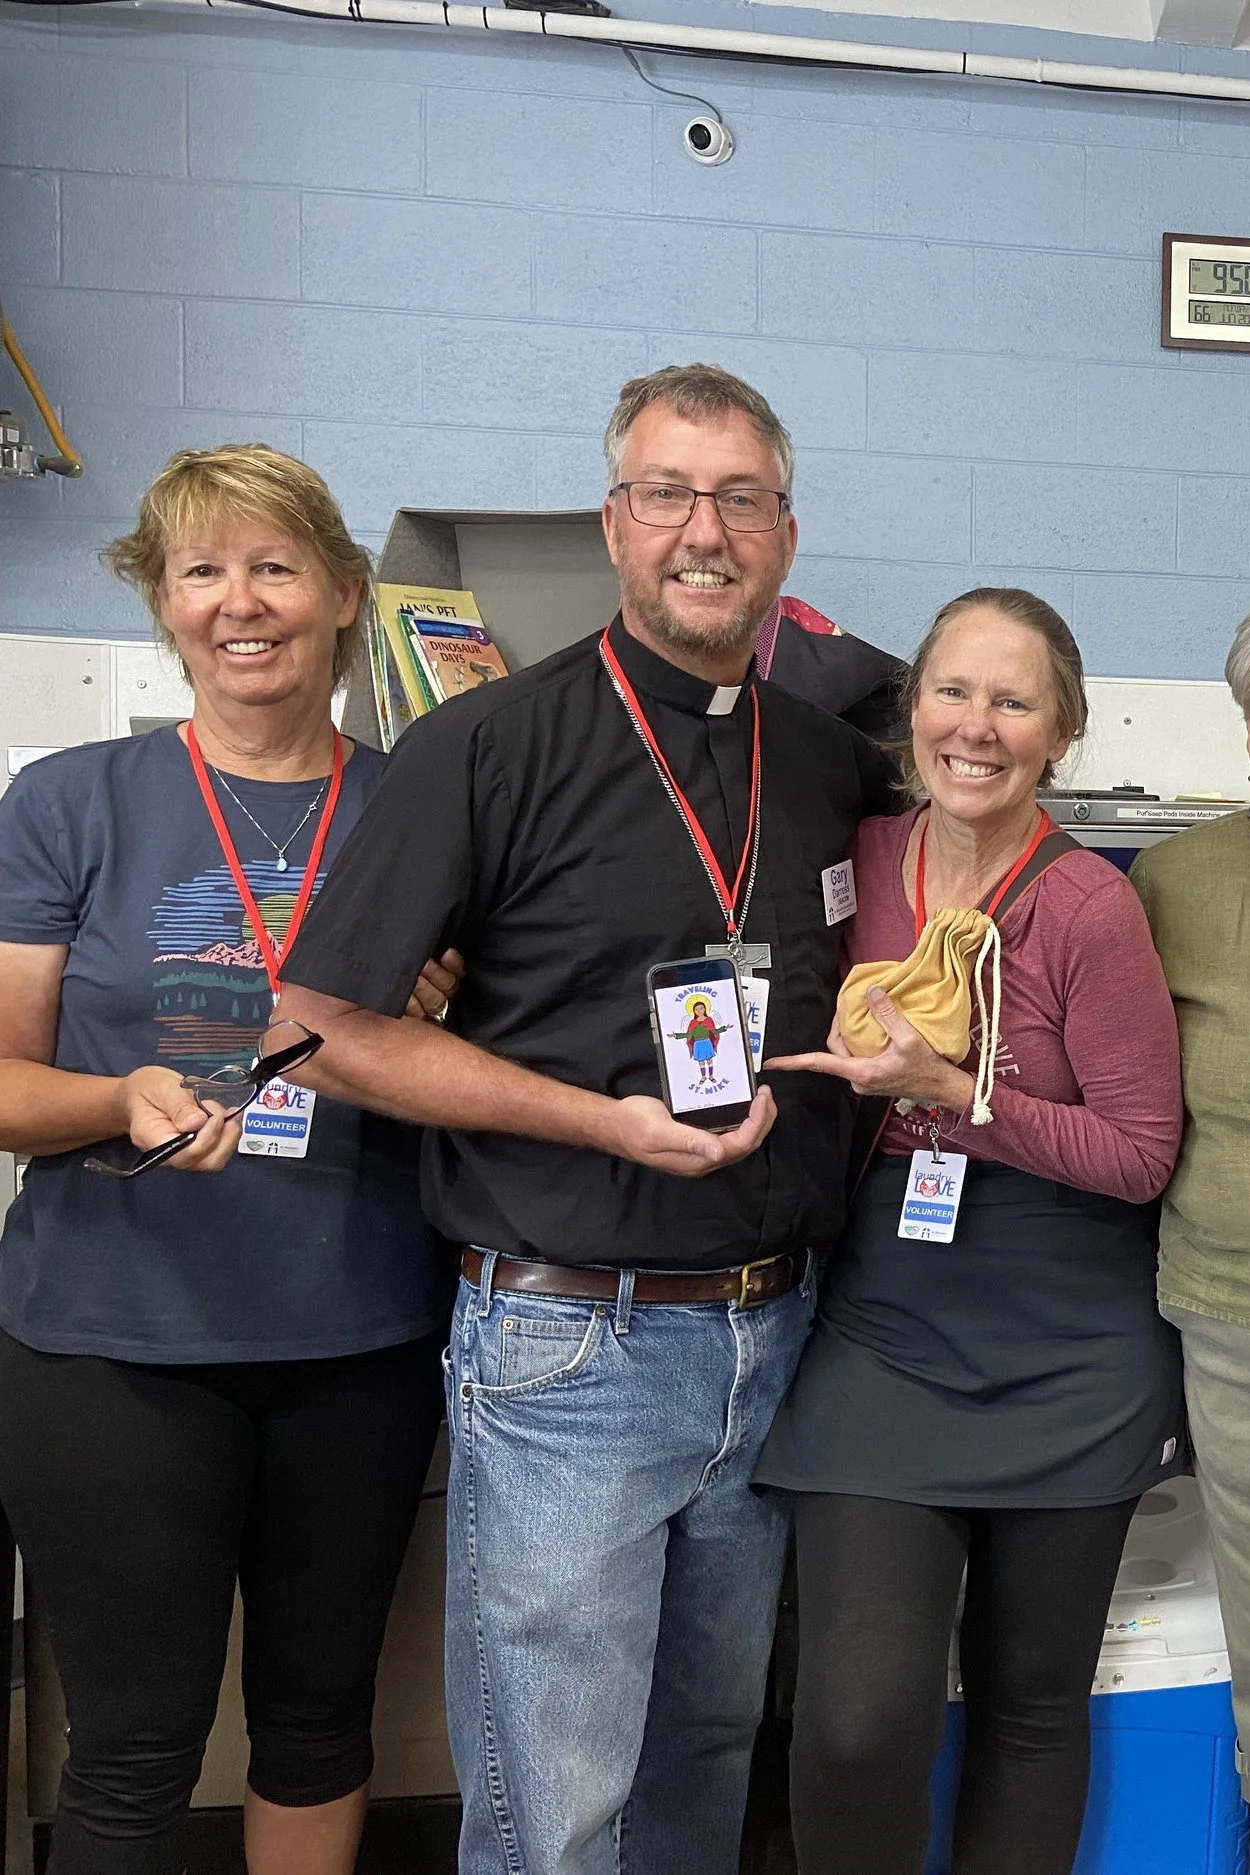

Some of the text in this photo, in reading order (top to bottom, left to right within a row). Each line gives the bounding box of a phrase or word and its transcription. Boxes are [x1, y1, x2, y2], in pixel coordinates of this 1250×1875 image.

[476, 630, 485, 640] 3
[429, 640, 482, 655] DINOSAUR
[440, 652, 466, 664] DAYS
[831, 868, 848, 886] Gary
[675, 985, 718, 1003] TRAVELING
[705, 1077, 730, 1095] MIKE
[247, 1119, 306, 1132] VOLUNTEER
[906, 1206, 954, 1219] VOLUNTEER
